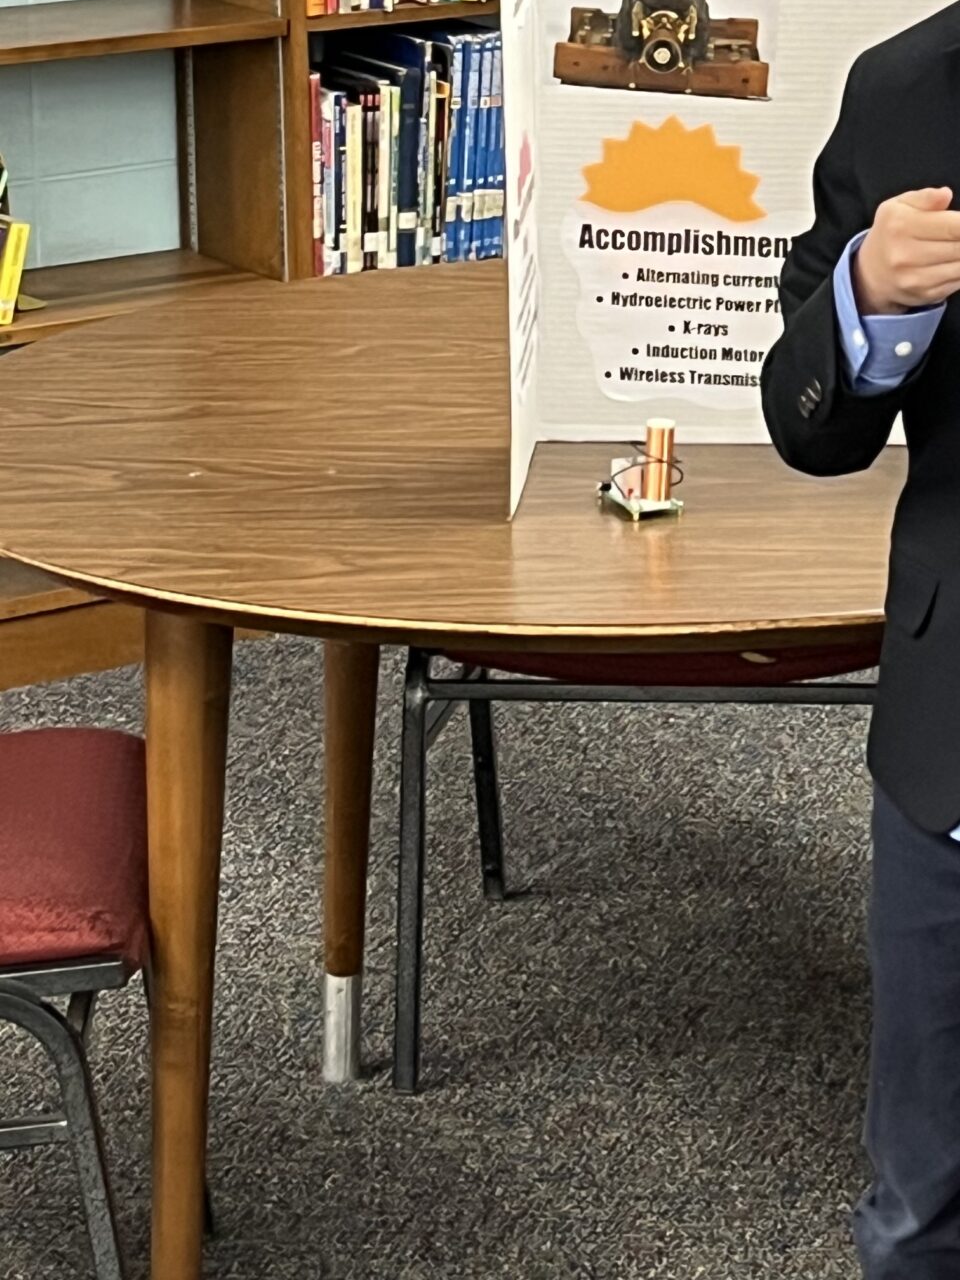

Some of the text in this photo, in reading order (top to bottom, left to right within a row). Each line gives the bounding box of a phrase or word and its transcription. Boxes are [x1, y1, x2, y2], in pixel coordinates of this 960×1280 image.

[636, 268, 720, 287] Alternating
[611, 292, 712, 310] Hydroelectric
[716, 297, 762, 312] Power
[683, 321, 729, 336] X-rays
[646, 344, 718, 360] Induction
[619, 367, 686, 383] Wireless
